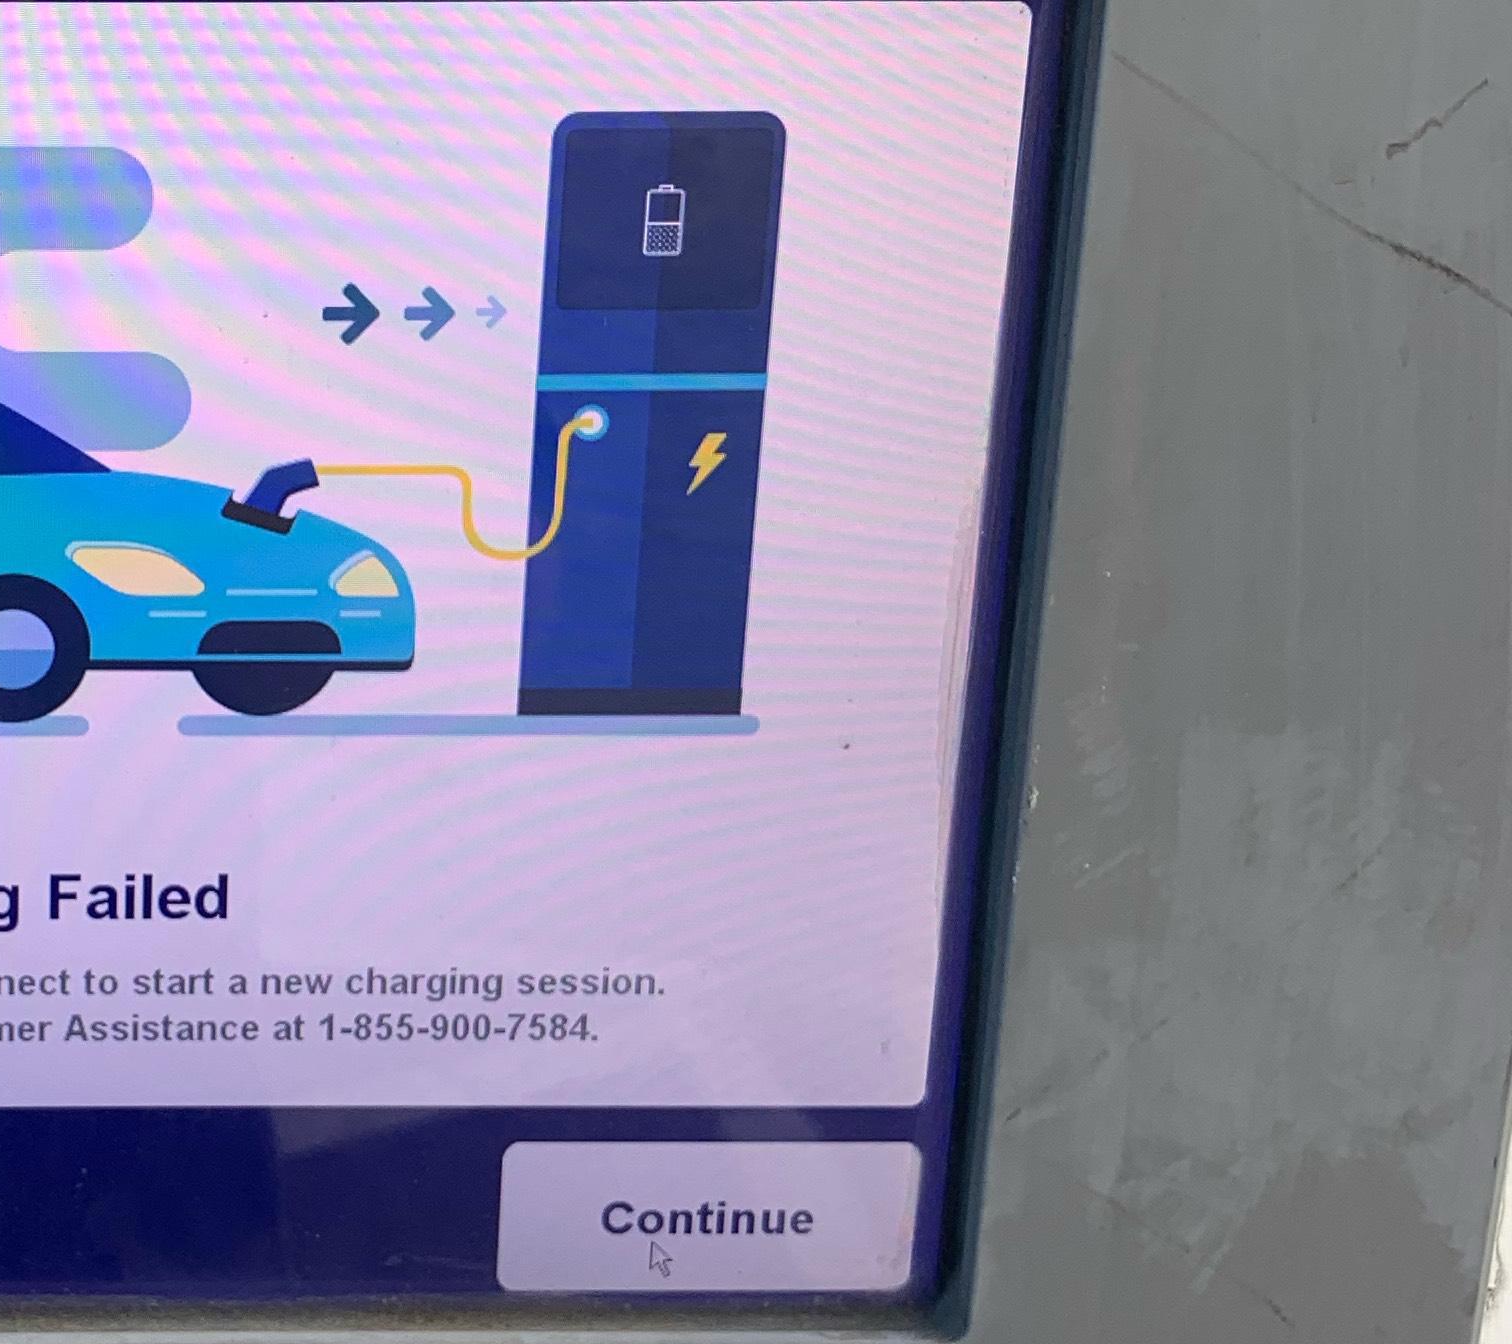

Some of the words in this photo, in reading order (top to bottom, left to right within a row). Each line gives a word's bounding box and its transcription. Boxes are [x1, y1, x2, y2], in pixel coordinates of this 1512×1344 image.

[48, 873, 230, 921] Failed
[84, 969, 119, 997] to
[132, 969, 215, 997] start
[228, 975, 249, 996] a
[261, 974, 333, 996] new
[345, 967, 503, 1002] charging
[516, 966, 666, 996] session.
[64, 1013, 260, 1043] Assistance
[272, 1013, 306, 1042] at
[318, 1012, 599, 1042] 1-855-900-7584.
[601, 1199, 815, 1235] Continue
